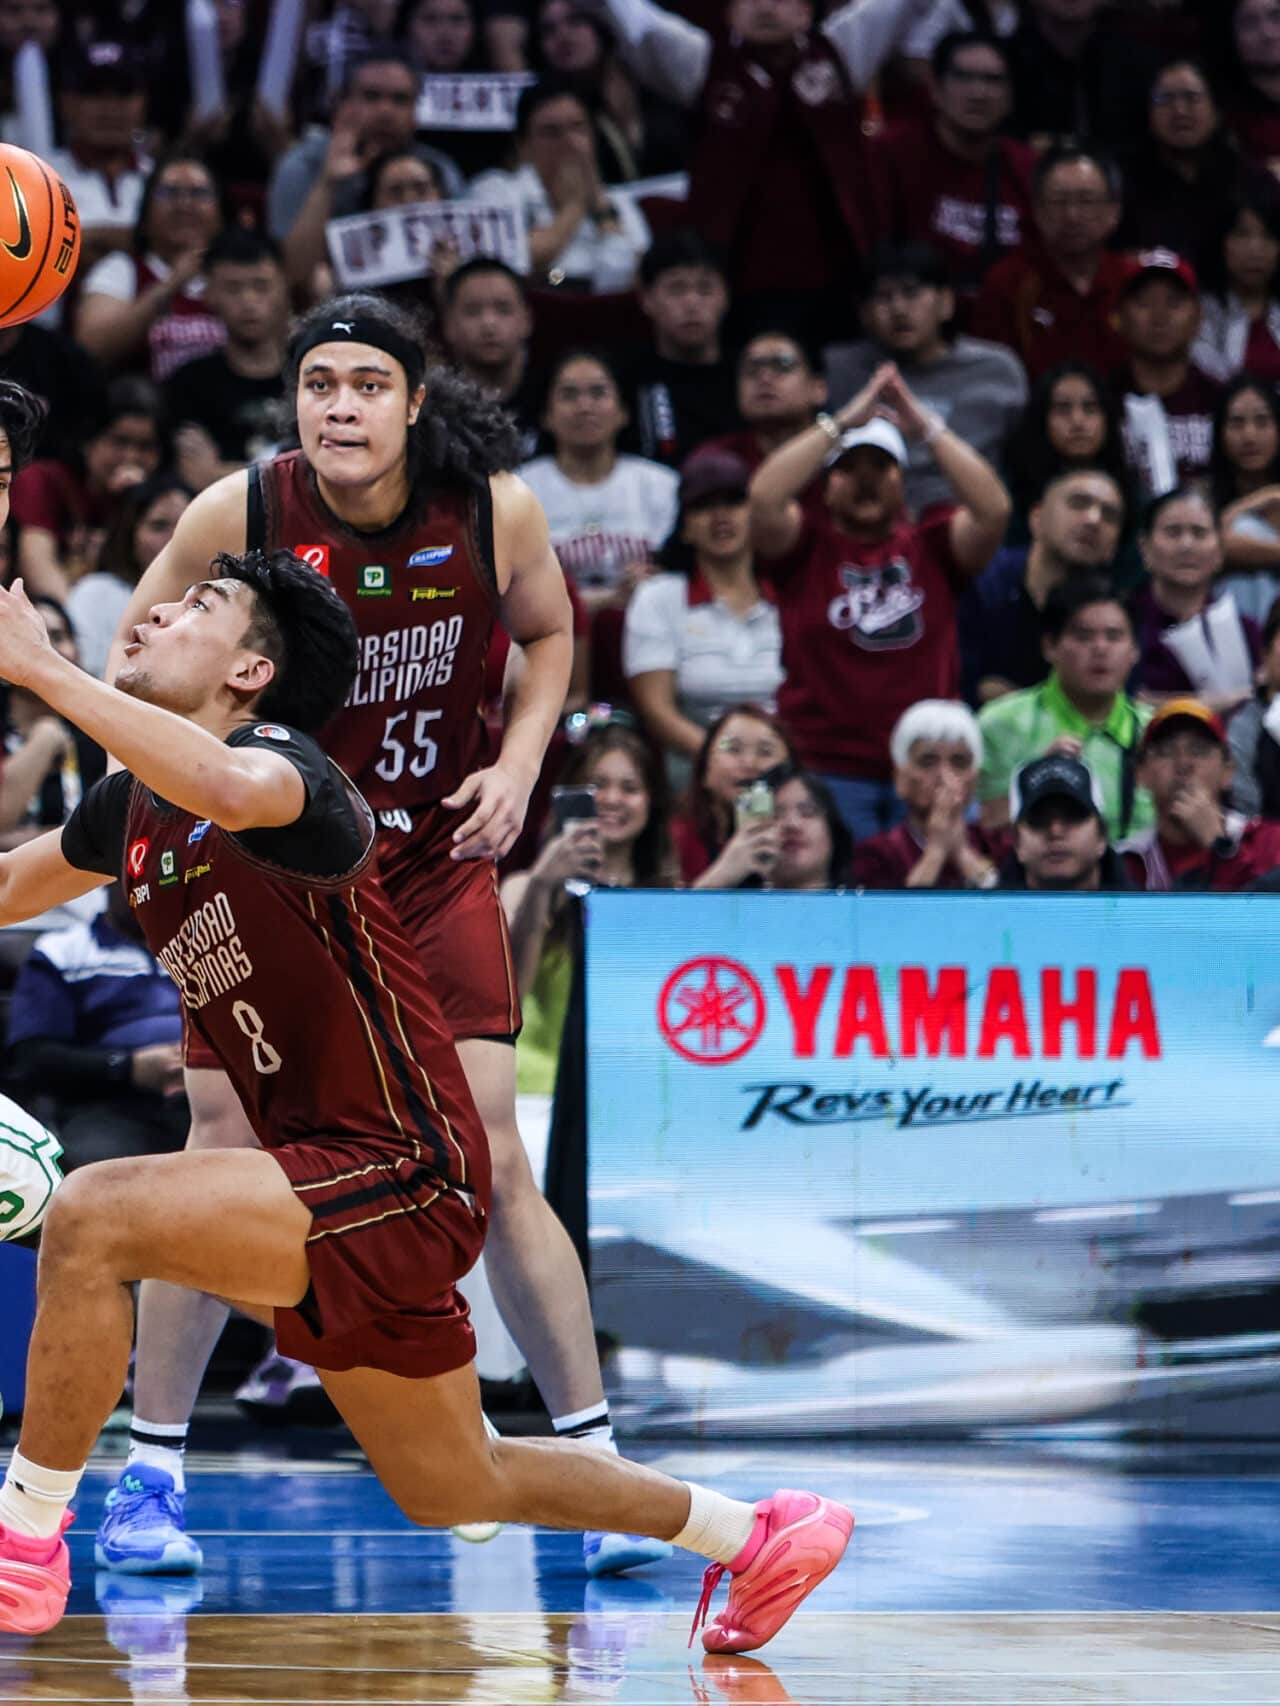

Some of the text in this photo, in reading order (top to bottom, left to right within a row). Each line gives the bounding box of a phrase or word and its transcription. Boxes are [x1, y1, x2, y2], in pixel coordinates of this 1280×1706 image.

[357, 614, 464, 672] RSIDAD
[375, 709, 443, 782] 55
[232, 1000, 282, 1094] 8
[774, 963, 1163, 1061] YAMAHA
[740, 1076, 1125, 1131] Revs Your Heart
